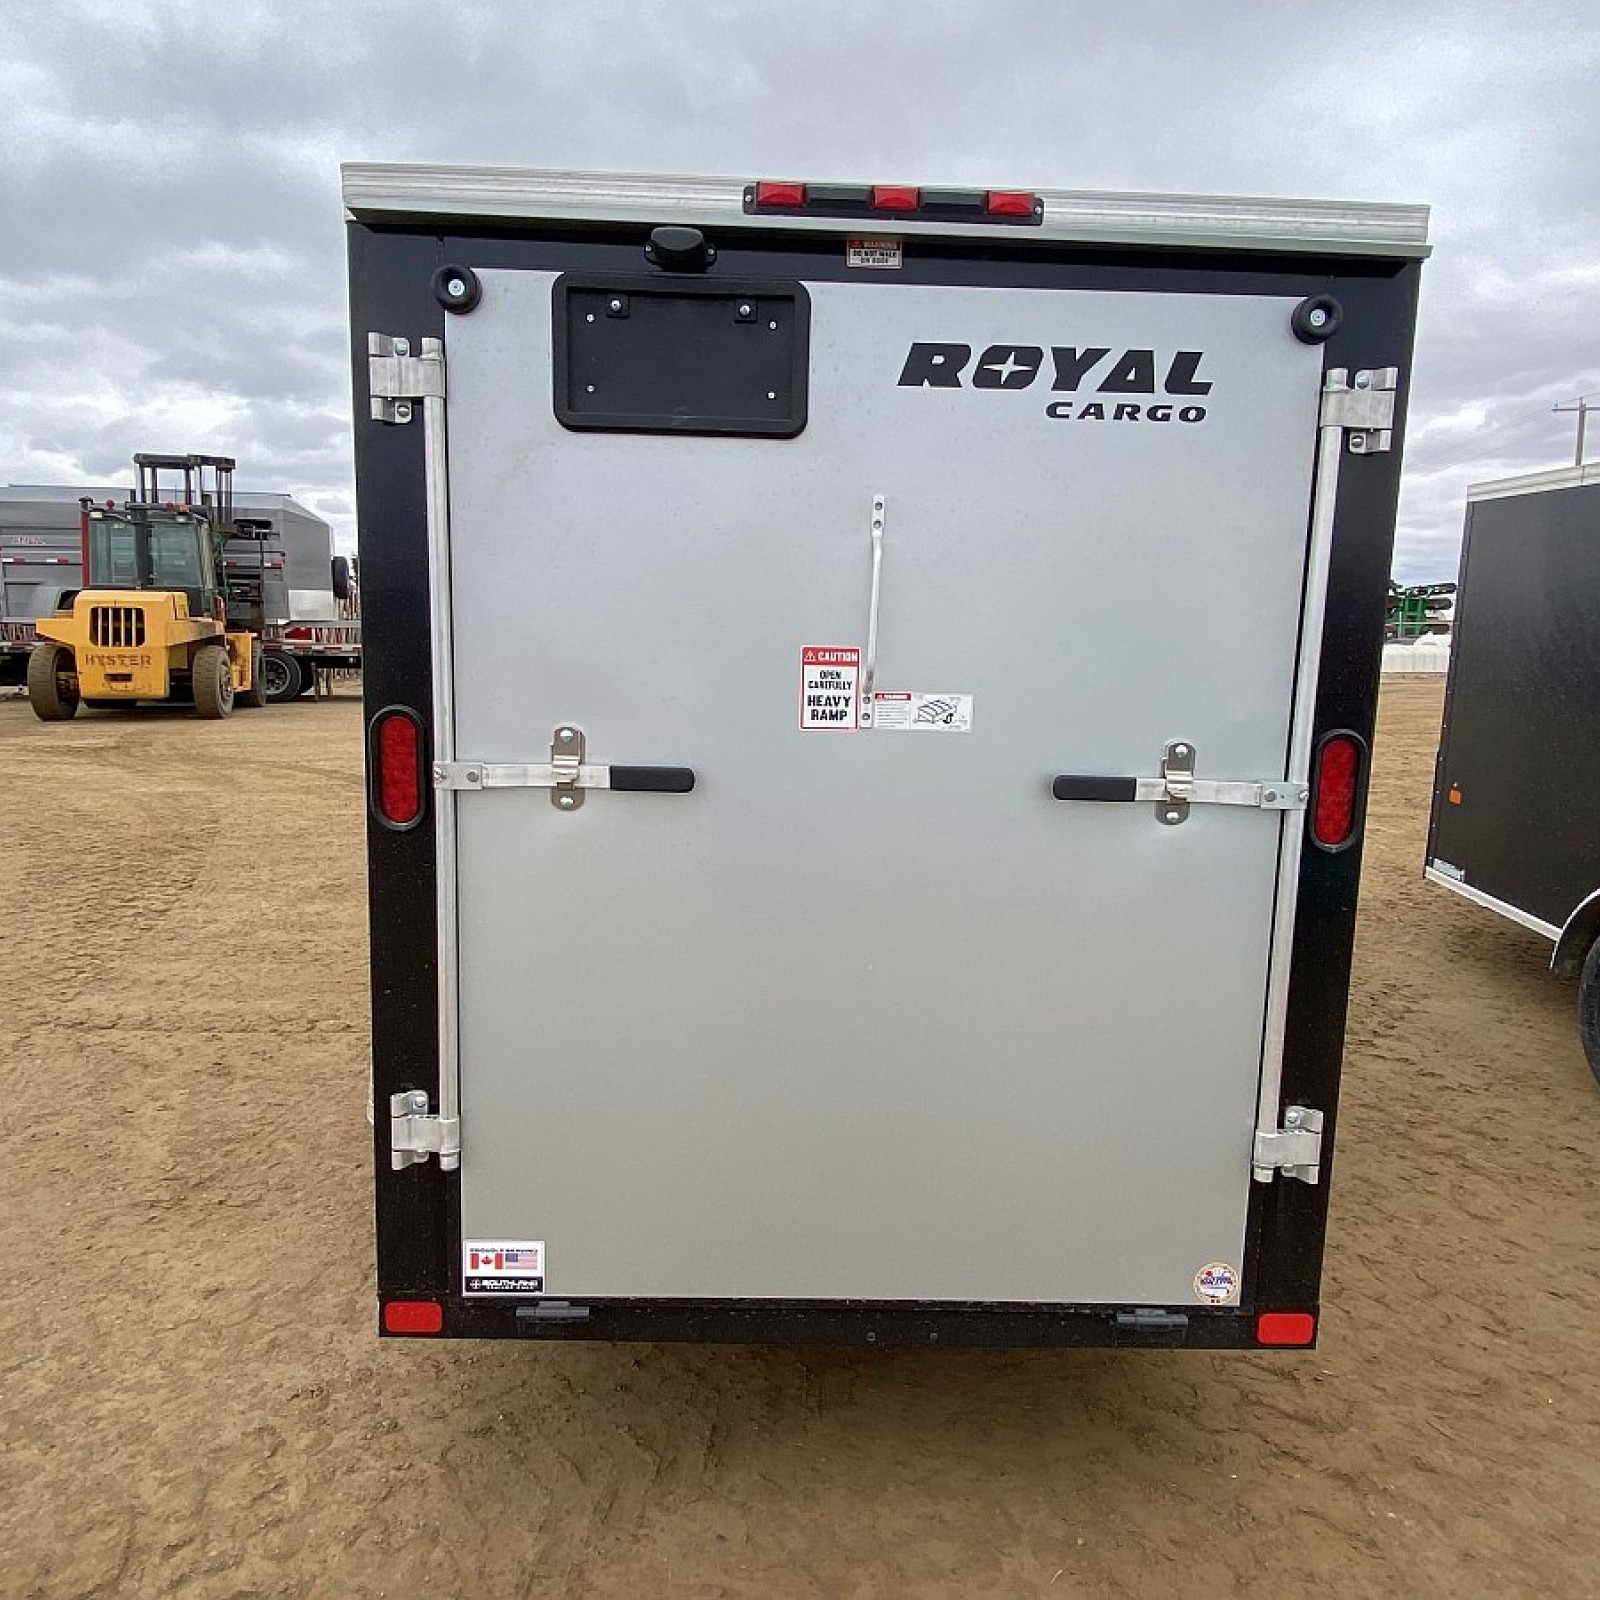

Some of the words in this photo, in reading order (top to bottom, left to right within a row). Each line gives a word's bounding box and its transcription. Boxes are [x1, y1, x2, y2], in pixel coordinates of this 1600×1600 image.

[897, 342, 1214, 396] ROYAL
[1045, 401, 1207, 423] CARGO
[85, 653, 152, 667] HYSTER
[817, 650, 858, 662] CAUTION
[819, 670, 842, 680] OPEN
[807, 680, 853, 690] CAREFULLY
[807, 694, 851, 707] HEAVY
[810, 708, 847, 721] RAMP
